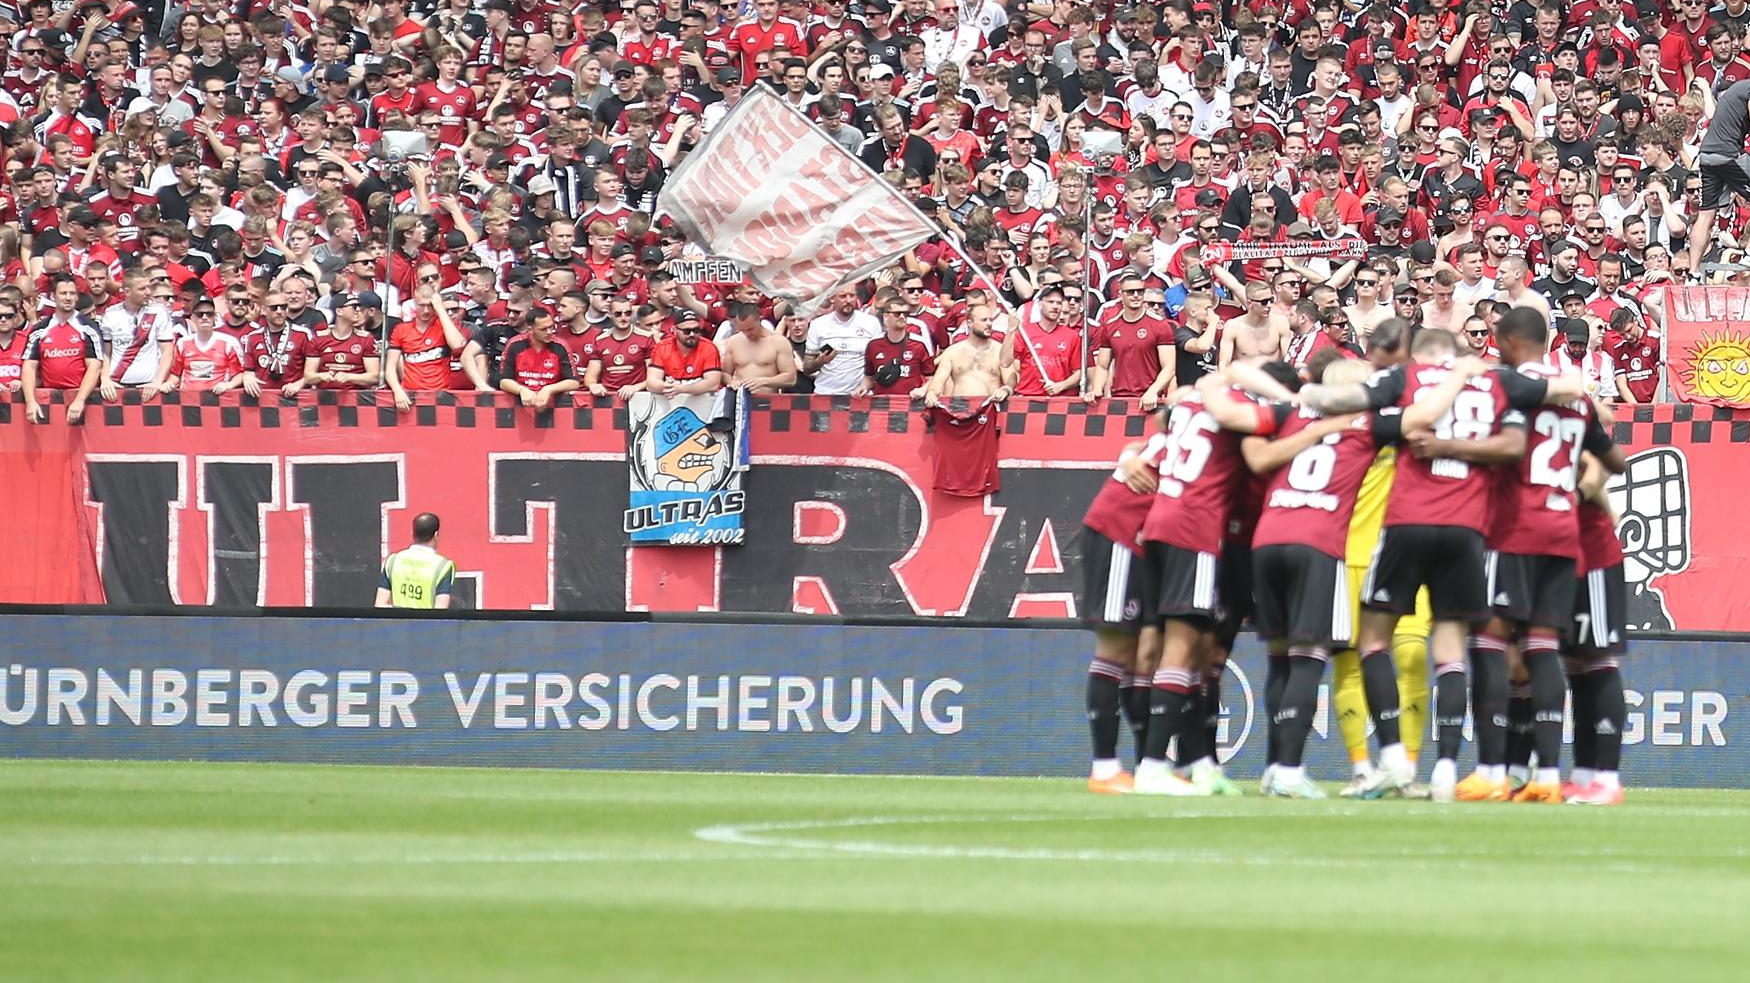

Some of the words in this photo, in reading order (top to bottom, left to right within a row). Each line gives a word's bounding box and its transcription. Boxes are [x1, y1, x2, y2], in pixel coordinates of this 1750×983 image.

[44, 348, 80, 359] Adecco
[622, 491, 746, 533] ULTRAS
[669, 528, 699, 545] seit
[700, 527, 745, 546] 2002
[444, 671, 964, 735] VERSICHERUNG
